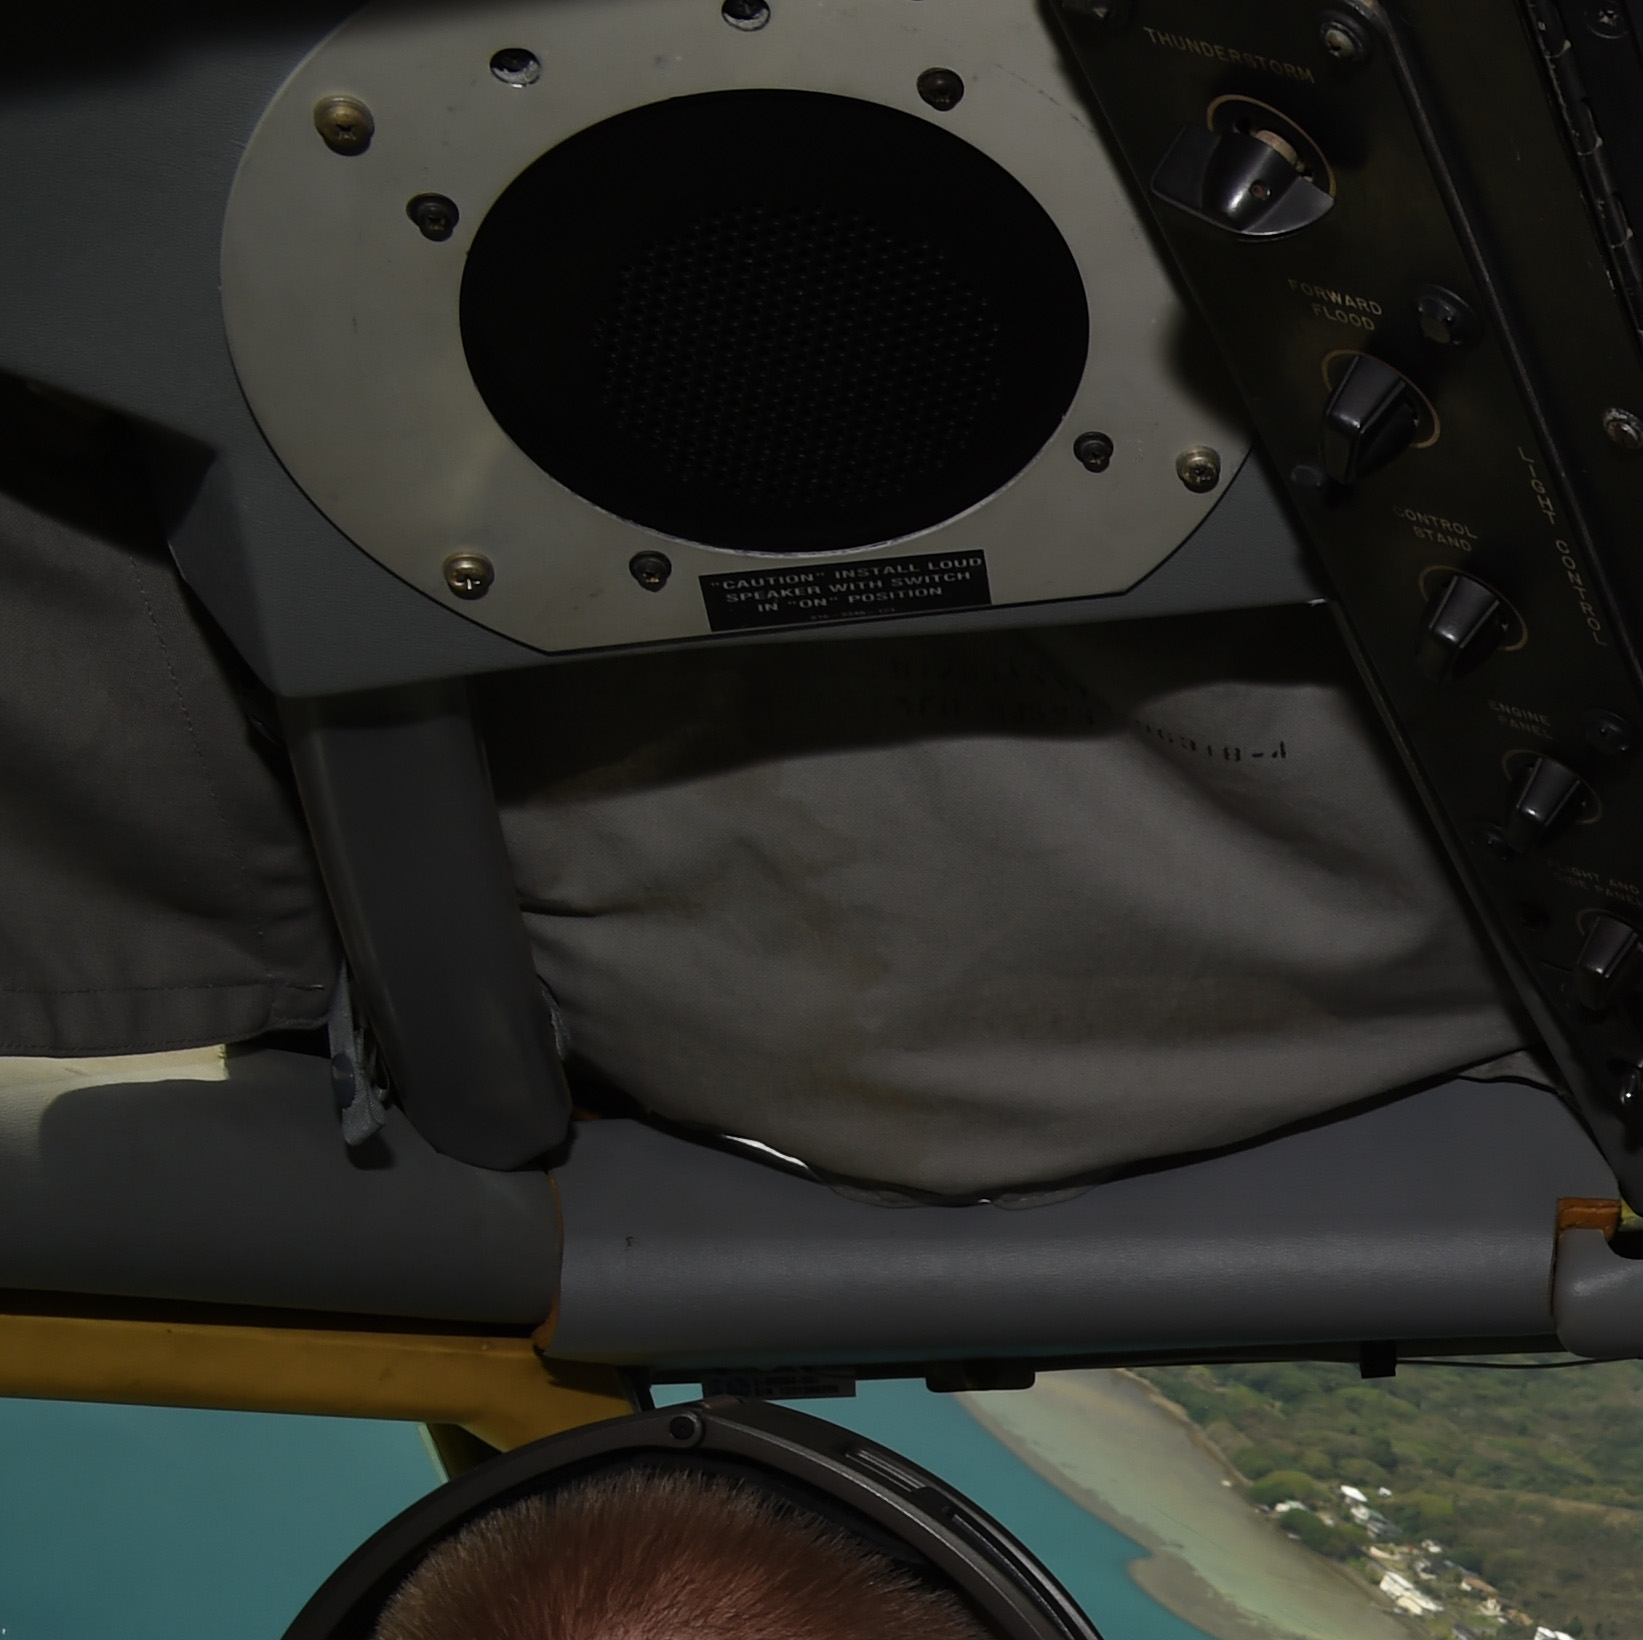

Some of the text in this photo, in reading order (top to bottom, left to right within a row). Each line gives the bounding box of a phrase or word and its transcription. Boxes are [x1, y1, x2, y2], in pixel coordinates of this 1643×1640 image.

[1143, 26, 1314, 83] THUNDERSTORM
[1288, 279, 1382, 315] FORWARD
[1314, 303, 1375, 330] FLOOD
[1394, 509, 1478, 539] CONTROL
[1413, 523, 1472, 551] STAND
[1518, 446, 1607, 646] LIGHT CONTROL
[711, 558, 981, 592] "CAUTION" INSTALL LOUD
[724, 572, 970, 603] SPEAKER WITH SWITCH
[758, 585, 942, 612] IN "ON" POSITION
